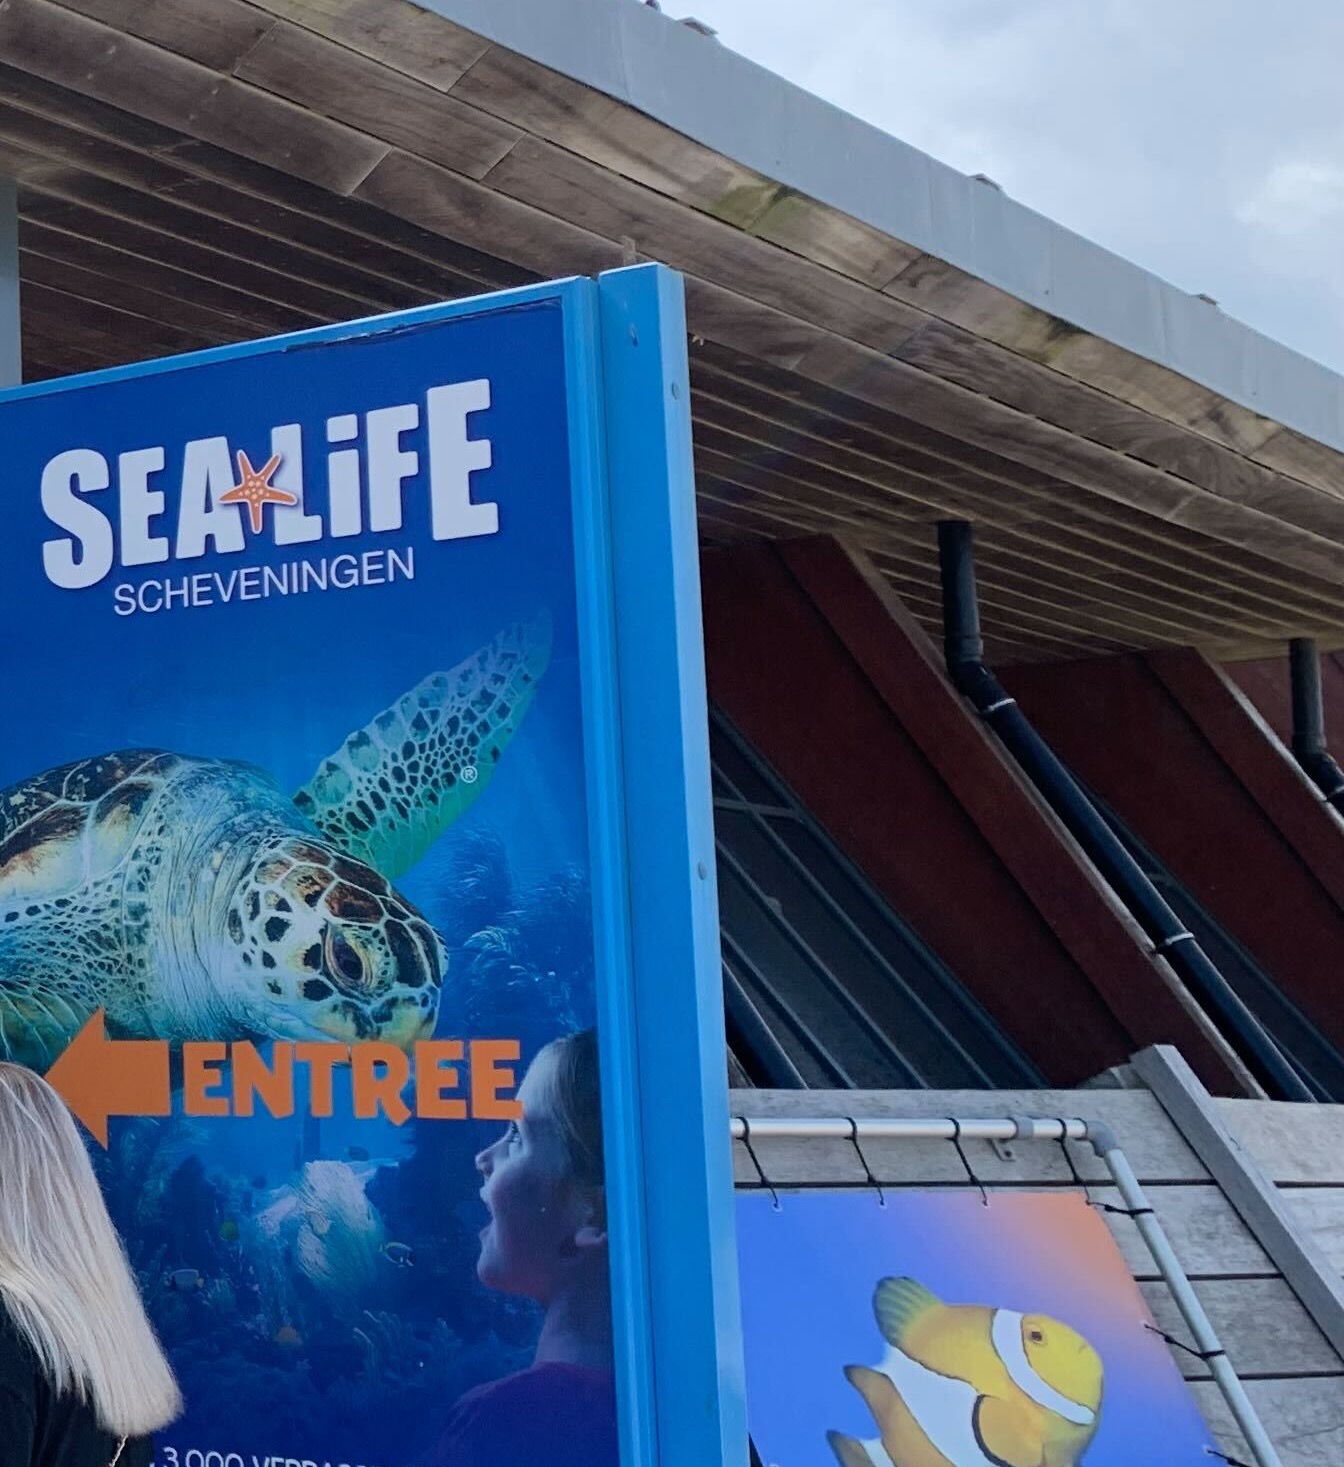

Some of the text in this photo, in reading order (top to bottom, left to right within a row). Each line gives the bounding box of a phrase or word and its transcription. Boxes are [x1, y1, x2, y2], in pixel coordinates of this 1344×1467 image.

[41, 436, 246, 590] SEA
[113, 546, 416, 617] SCHEVENINGEN
[182, 1038, 524, 1127] ENTREE
